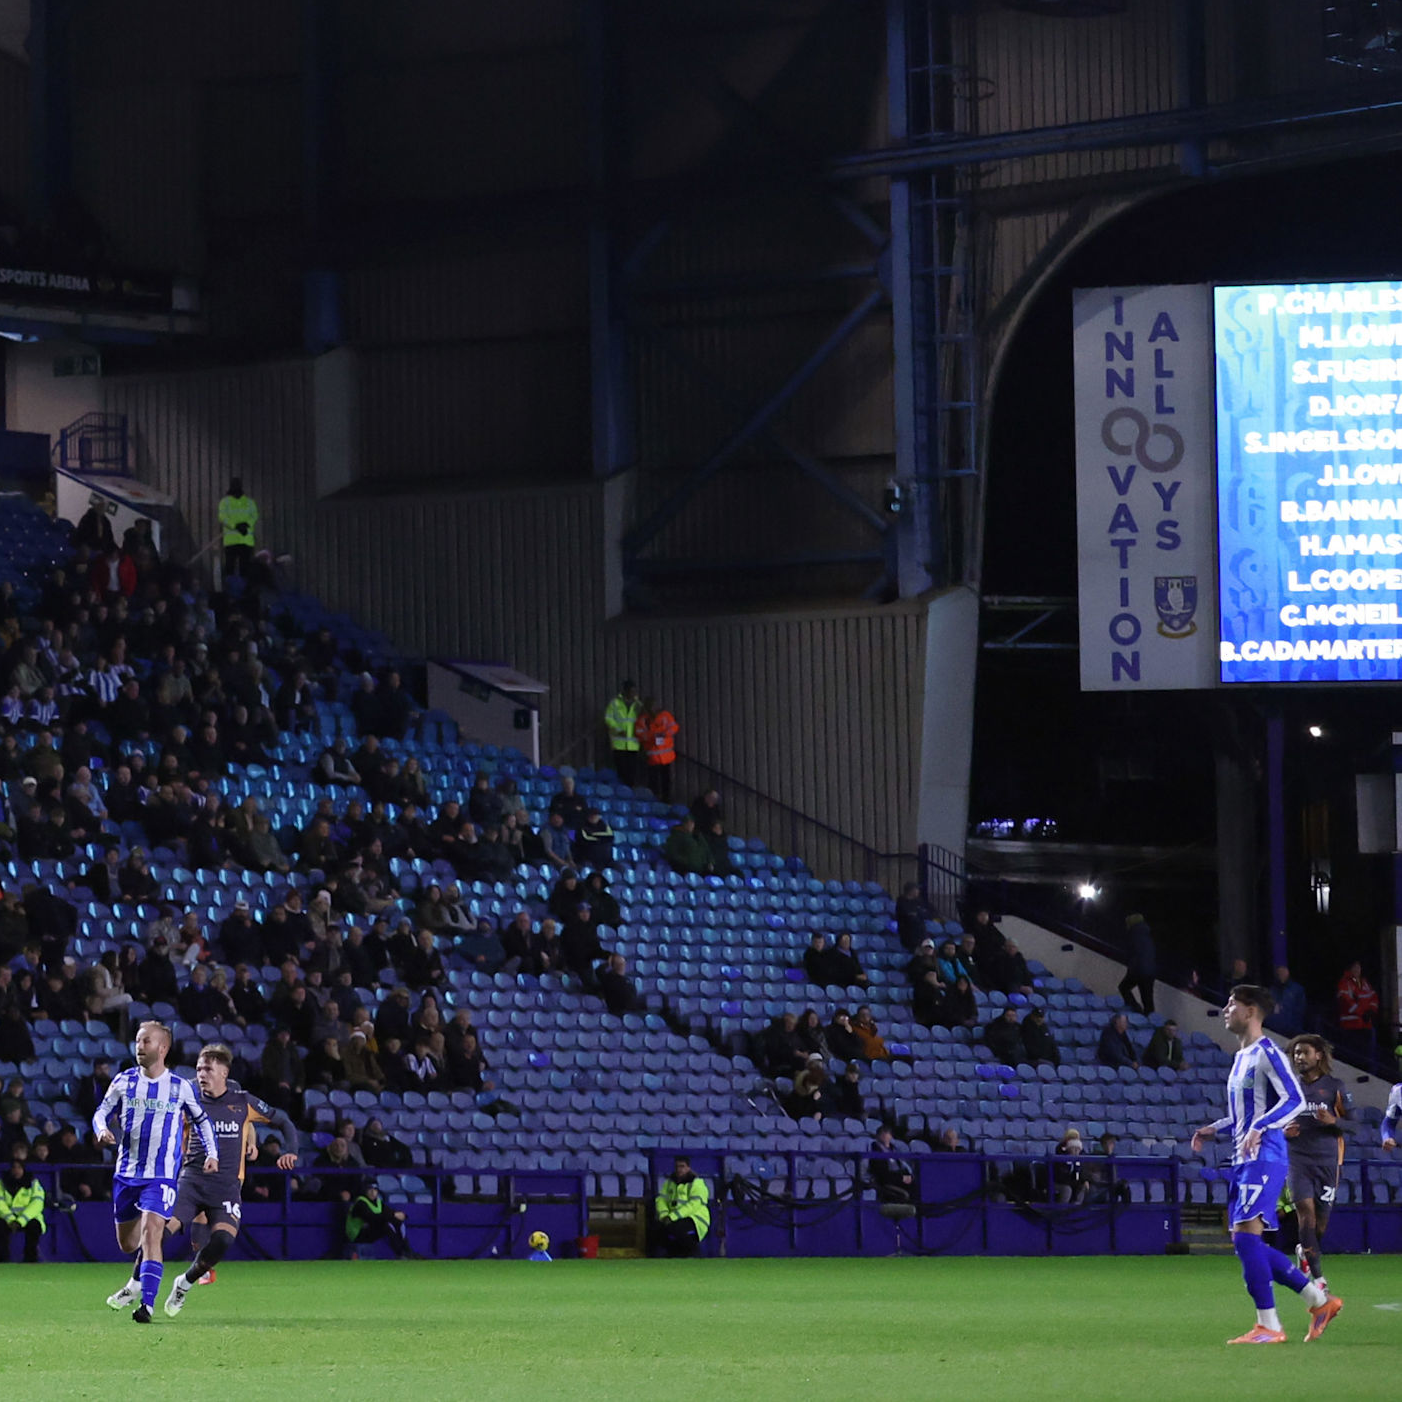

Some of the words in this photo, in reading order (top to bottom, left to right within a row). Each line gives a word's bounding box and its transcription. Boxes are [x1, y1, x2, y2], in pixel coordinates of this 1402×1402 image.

[48, 273, 90, 292] ARENA
[1137, 312, 1185, 551] ALLOYS
[1317, 463, 1402, 487] J.LOW
[1101, 296, 1148, 682] INNOVATION
[160, 1184, 177, 1207] 10
[1239, 1184, 1264, 1206] 17
[222, 1201, 242, 1217] 16
